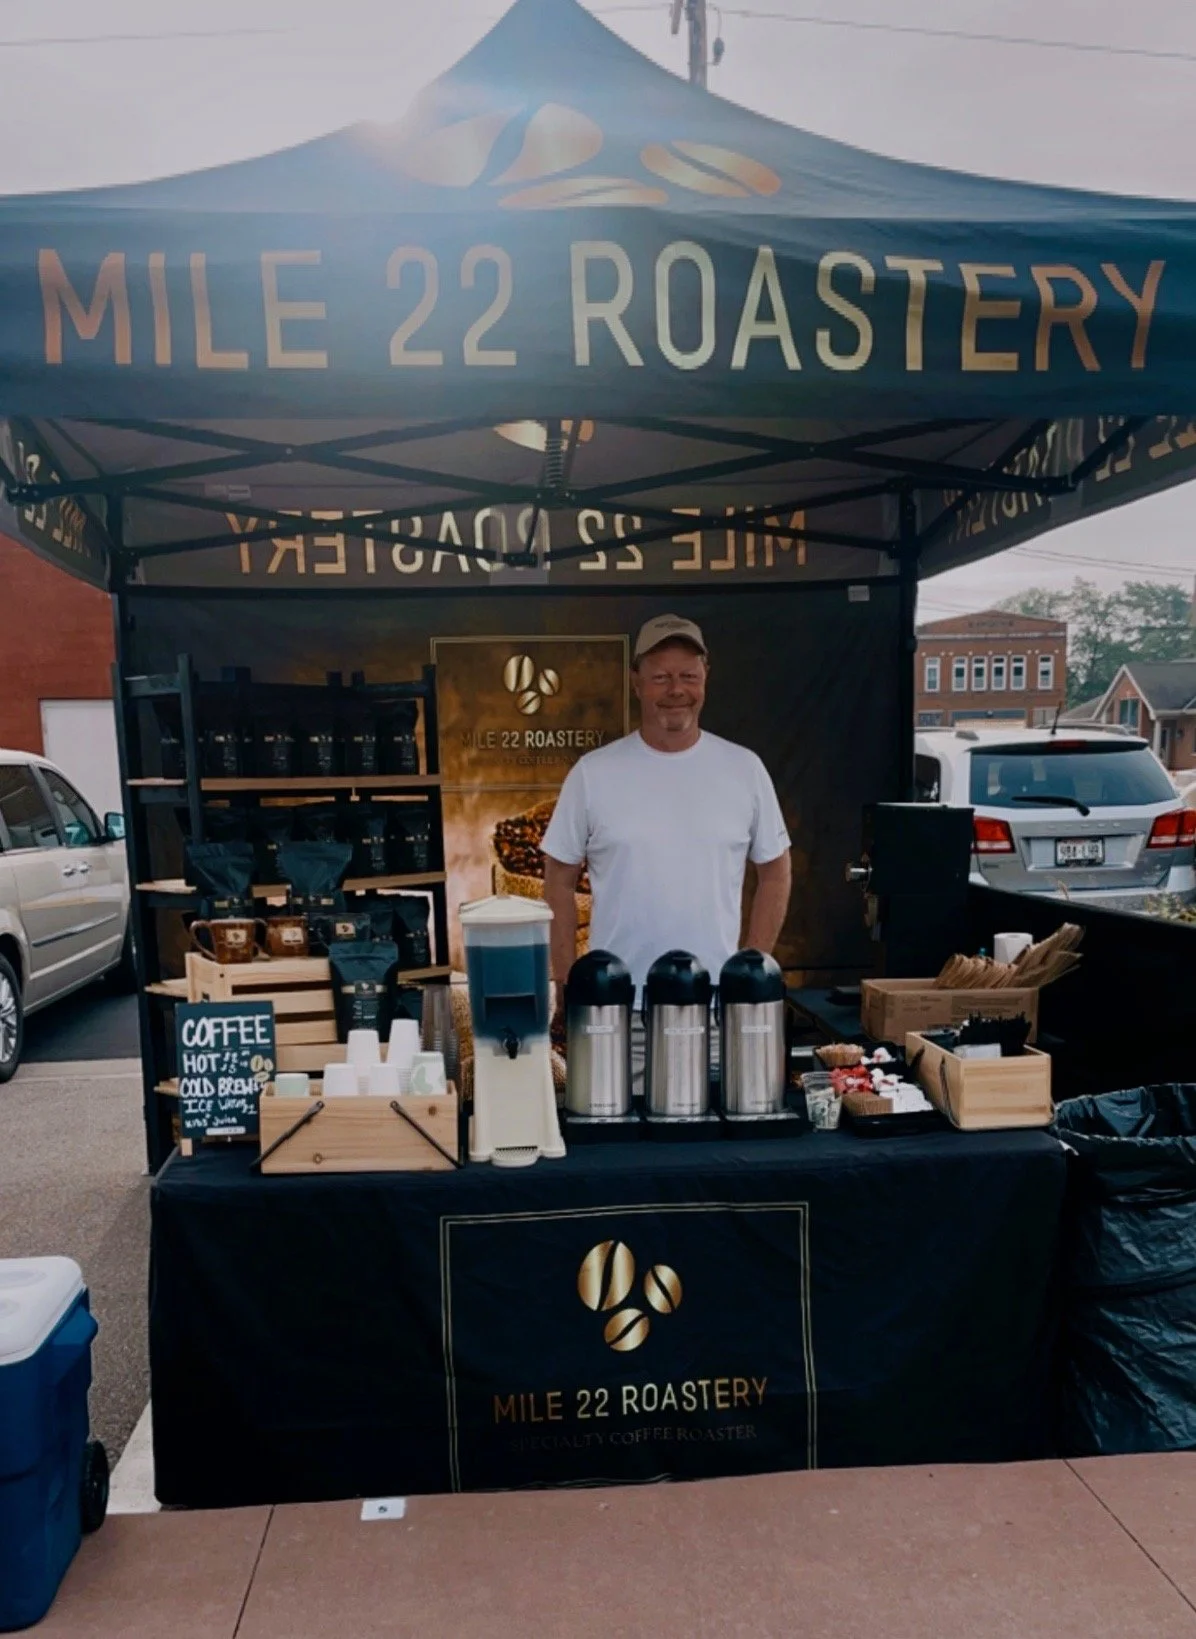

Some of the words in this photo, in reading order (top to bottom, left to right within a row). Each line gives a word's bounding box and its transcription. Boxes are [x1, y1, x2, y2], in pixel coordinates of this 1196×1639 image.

[38, 248, 328, 369] MILE
[386, 244, 517, 366] 22
[569, 240, 1166, 372] ROASTERY
[461, 731, 497, 749] MILE
[501, 731, 520, 749] 22
[524, 729, 606, 749] ROASTERY
[182, 1014, 271, 1047] COFFEE
[182, 1053, 221, 1074] HOT
[180, 1077, 216, 1098] COLD
[218, 1076, 254, 1098] BREW
[183, 1098, 214, 1115] ICE
[493, 1391, 564, 1424] MILE
[576, 1388, 610, 1418] 22
[622, 1377, 768, 1416] ROASTERY
[509, 1432, 605, 1451] SPECIALTY
[609, 1426, 672, 1445] COFFEE
[676, 1424, 757, 1442] ROASTER
